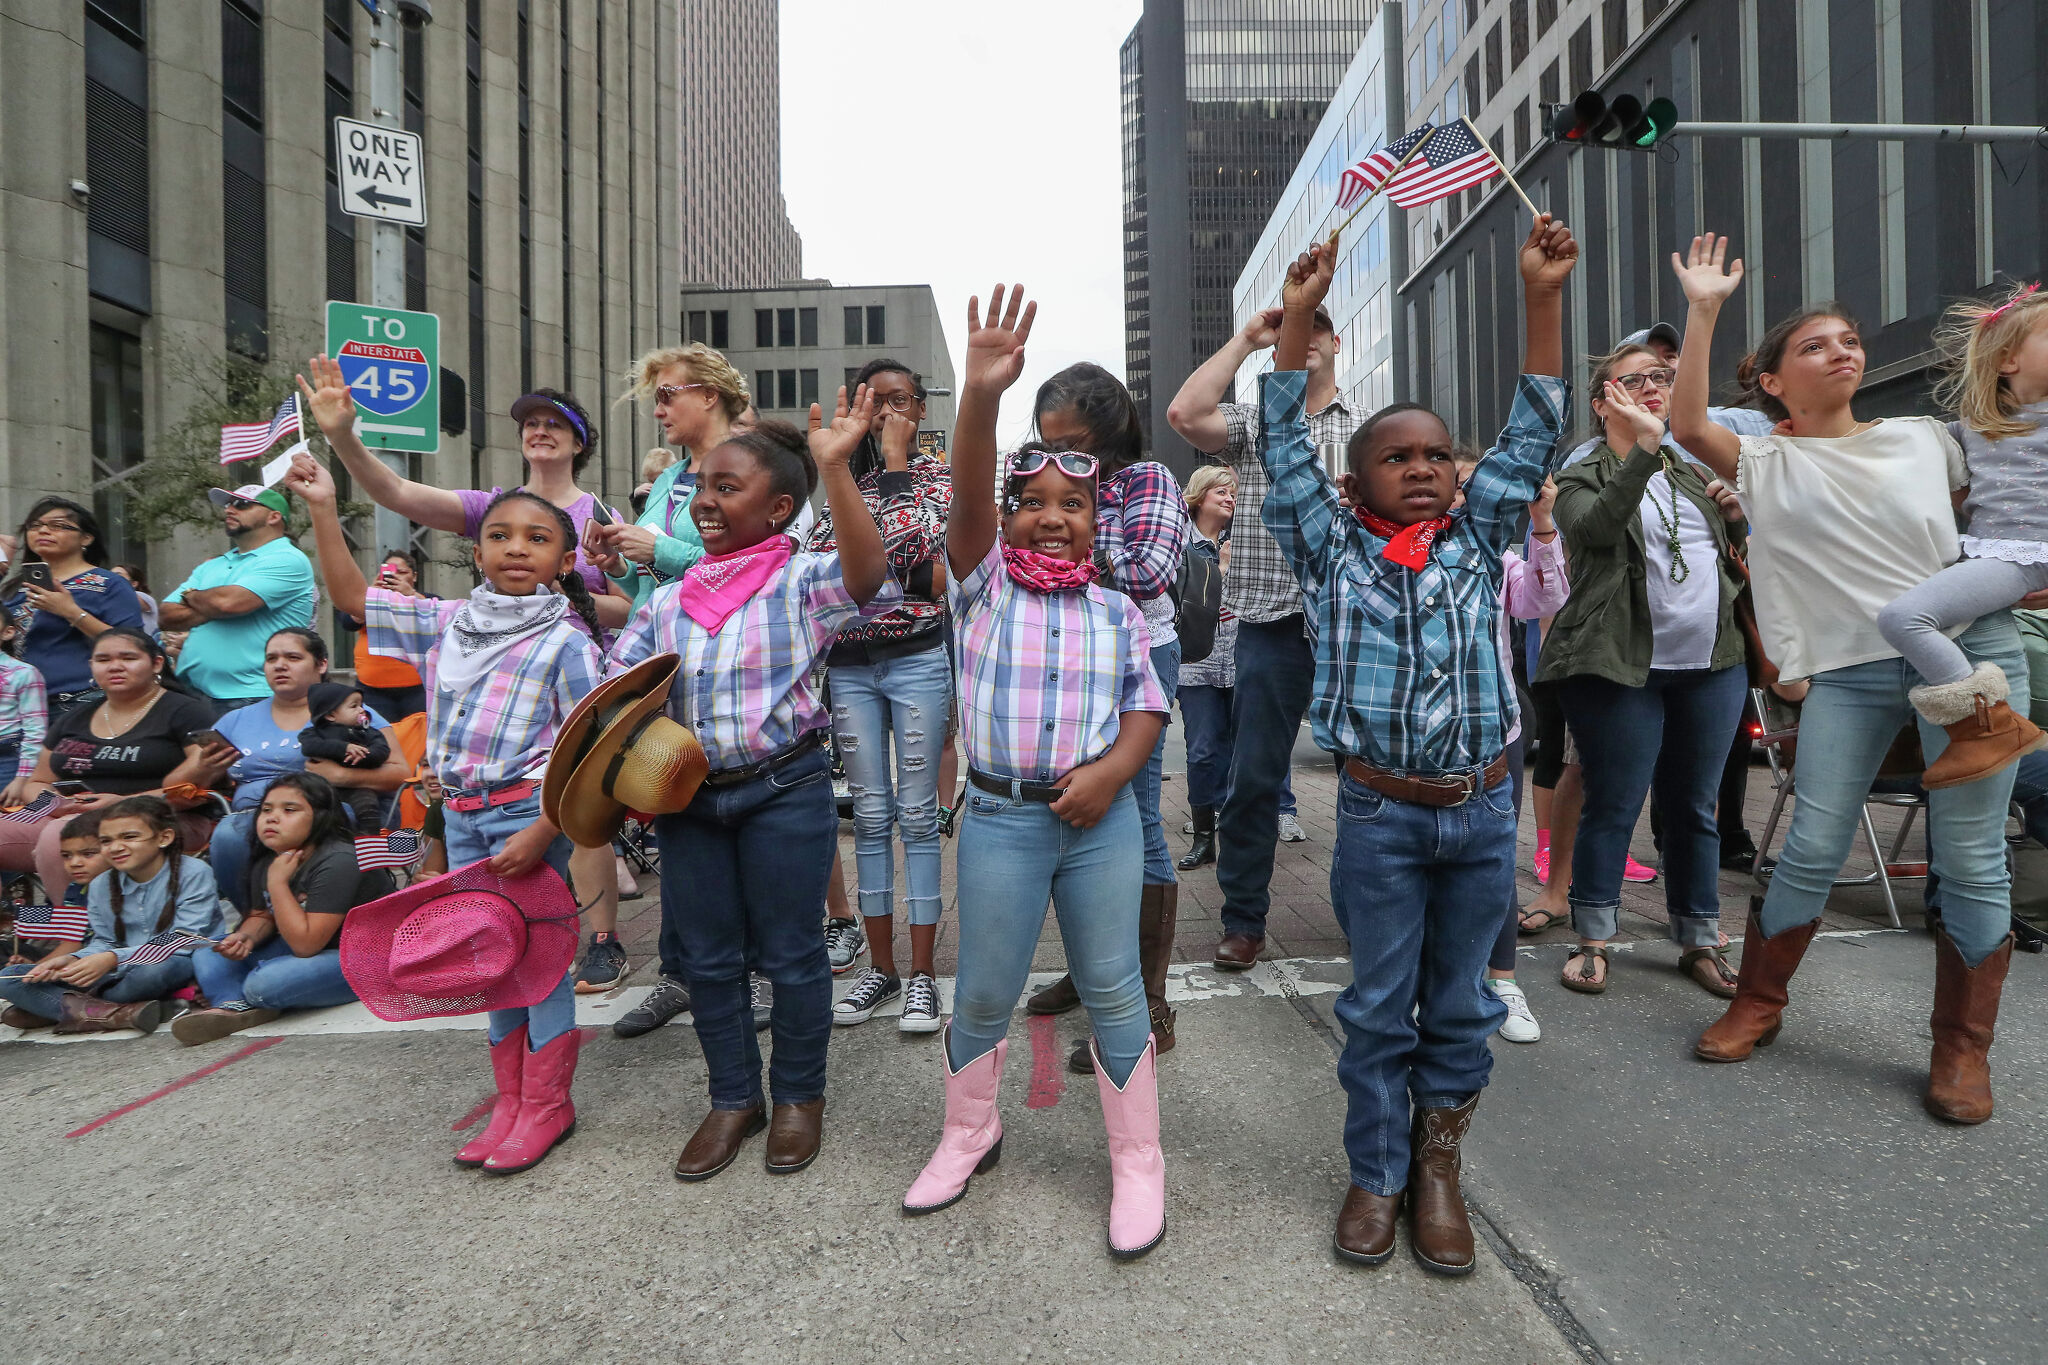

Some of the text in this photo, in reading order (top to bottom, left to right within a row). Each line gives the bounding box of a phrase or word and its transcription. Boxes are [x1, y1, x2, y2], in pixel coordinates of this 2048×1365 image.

[350, 130, 409, 160] ONE
[348, 154, 412, 185] WAY
[361, 315, 406, 340] TO
[350, 344, 417, 360] INTERSTATE
[350, 366, 416, 401] 45
[94, 745, 141, 762] A&M
